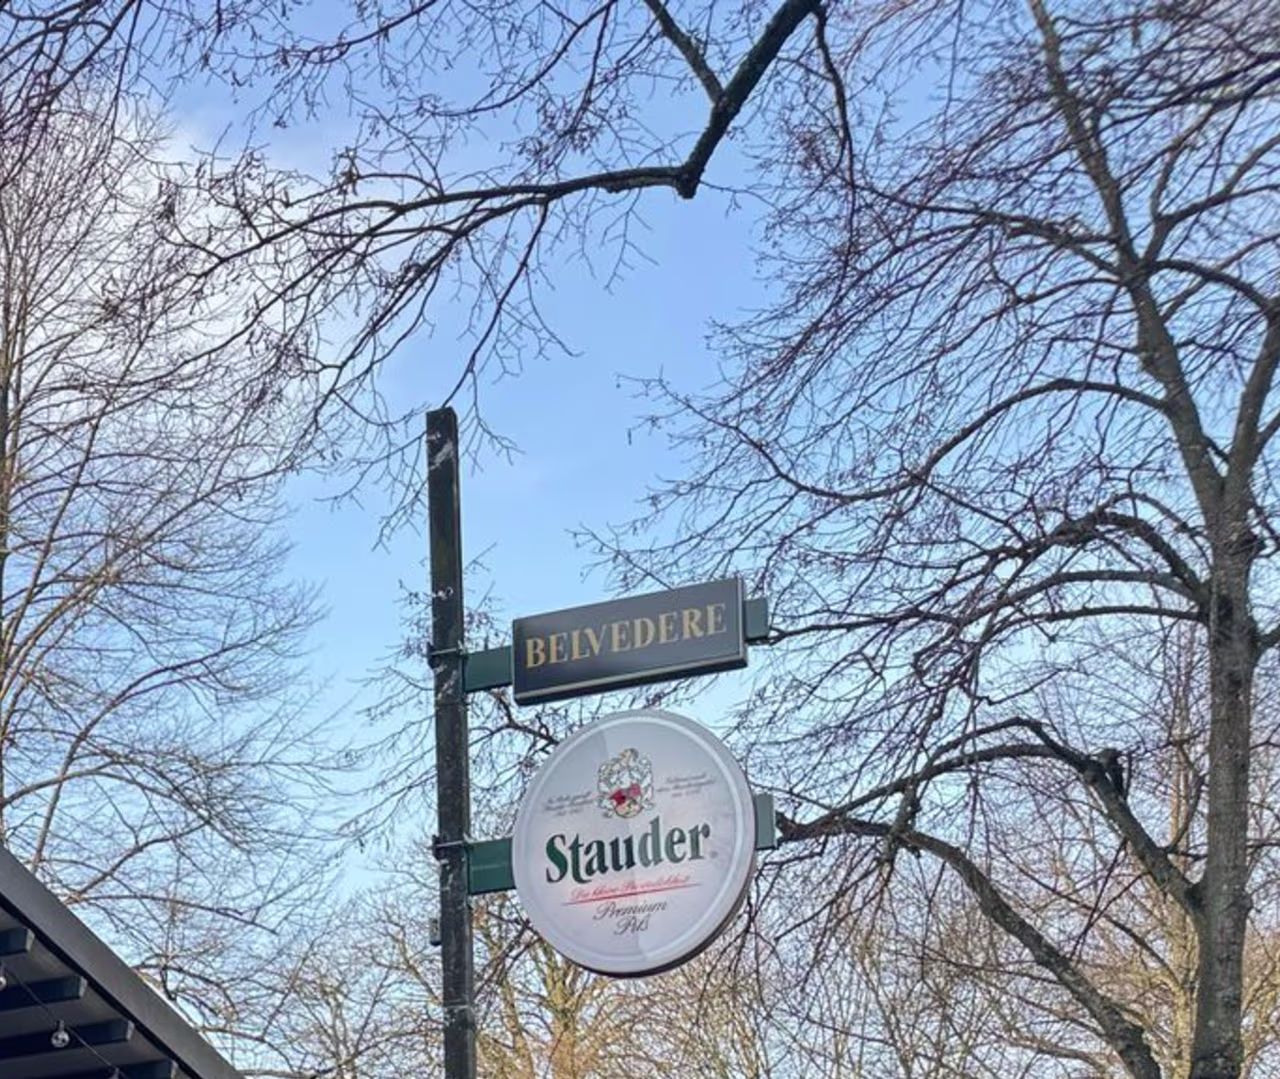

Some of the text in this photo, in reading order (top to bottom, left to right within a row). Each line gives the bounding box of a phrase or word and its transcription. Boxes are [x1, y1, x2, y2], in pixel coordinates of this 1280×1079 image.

[525, 603, 727, 669] BELVEDERE
[544, 815, 711, 884] Stauder
[593, 900, 668, 920] Premium
